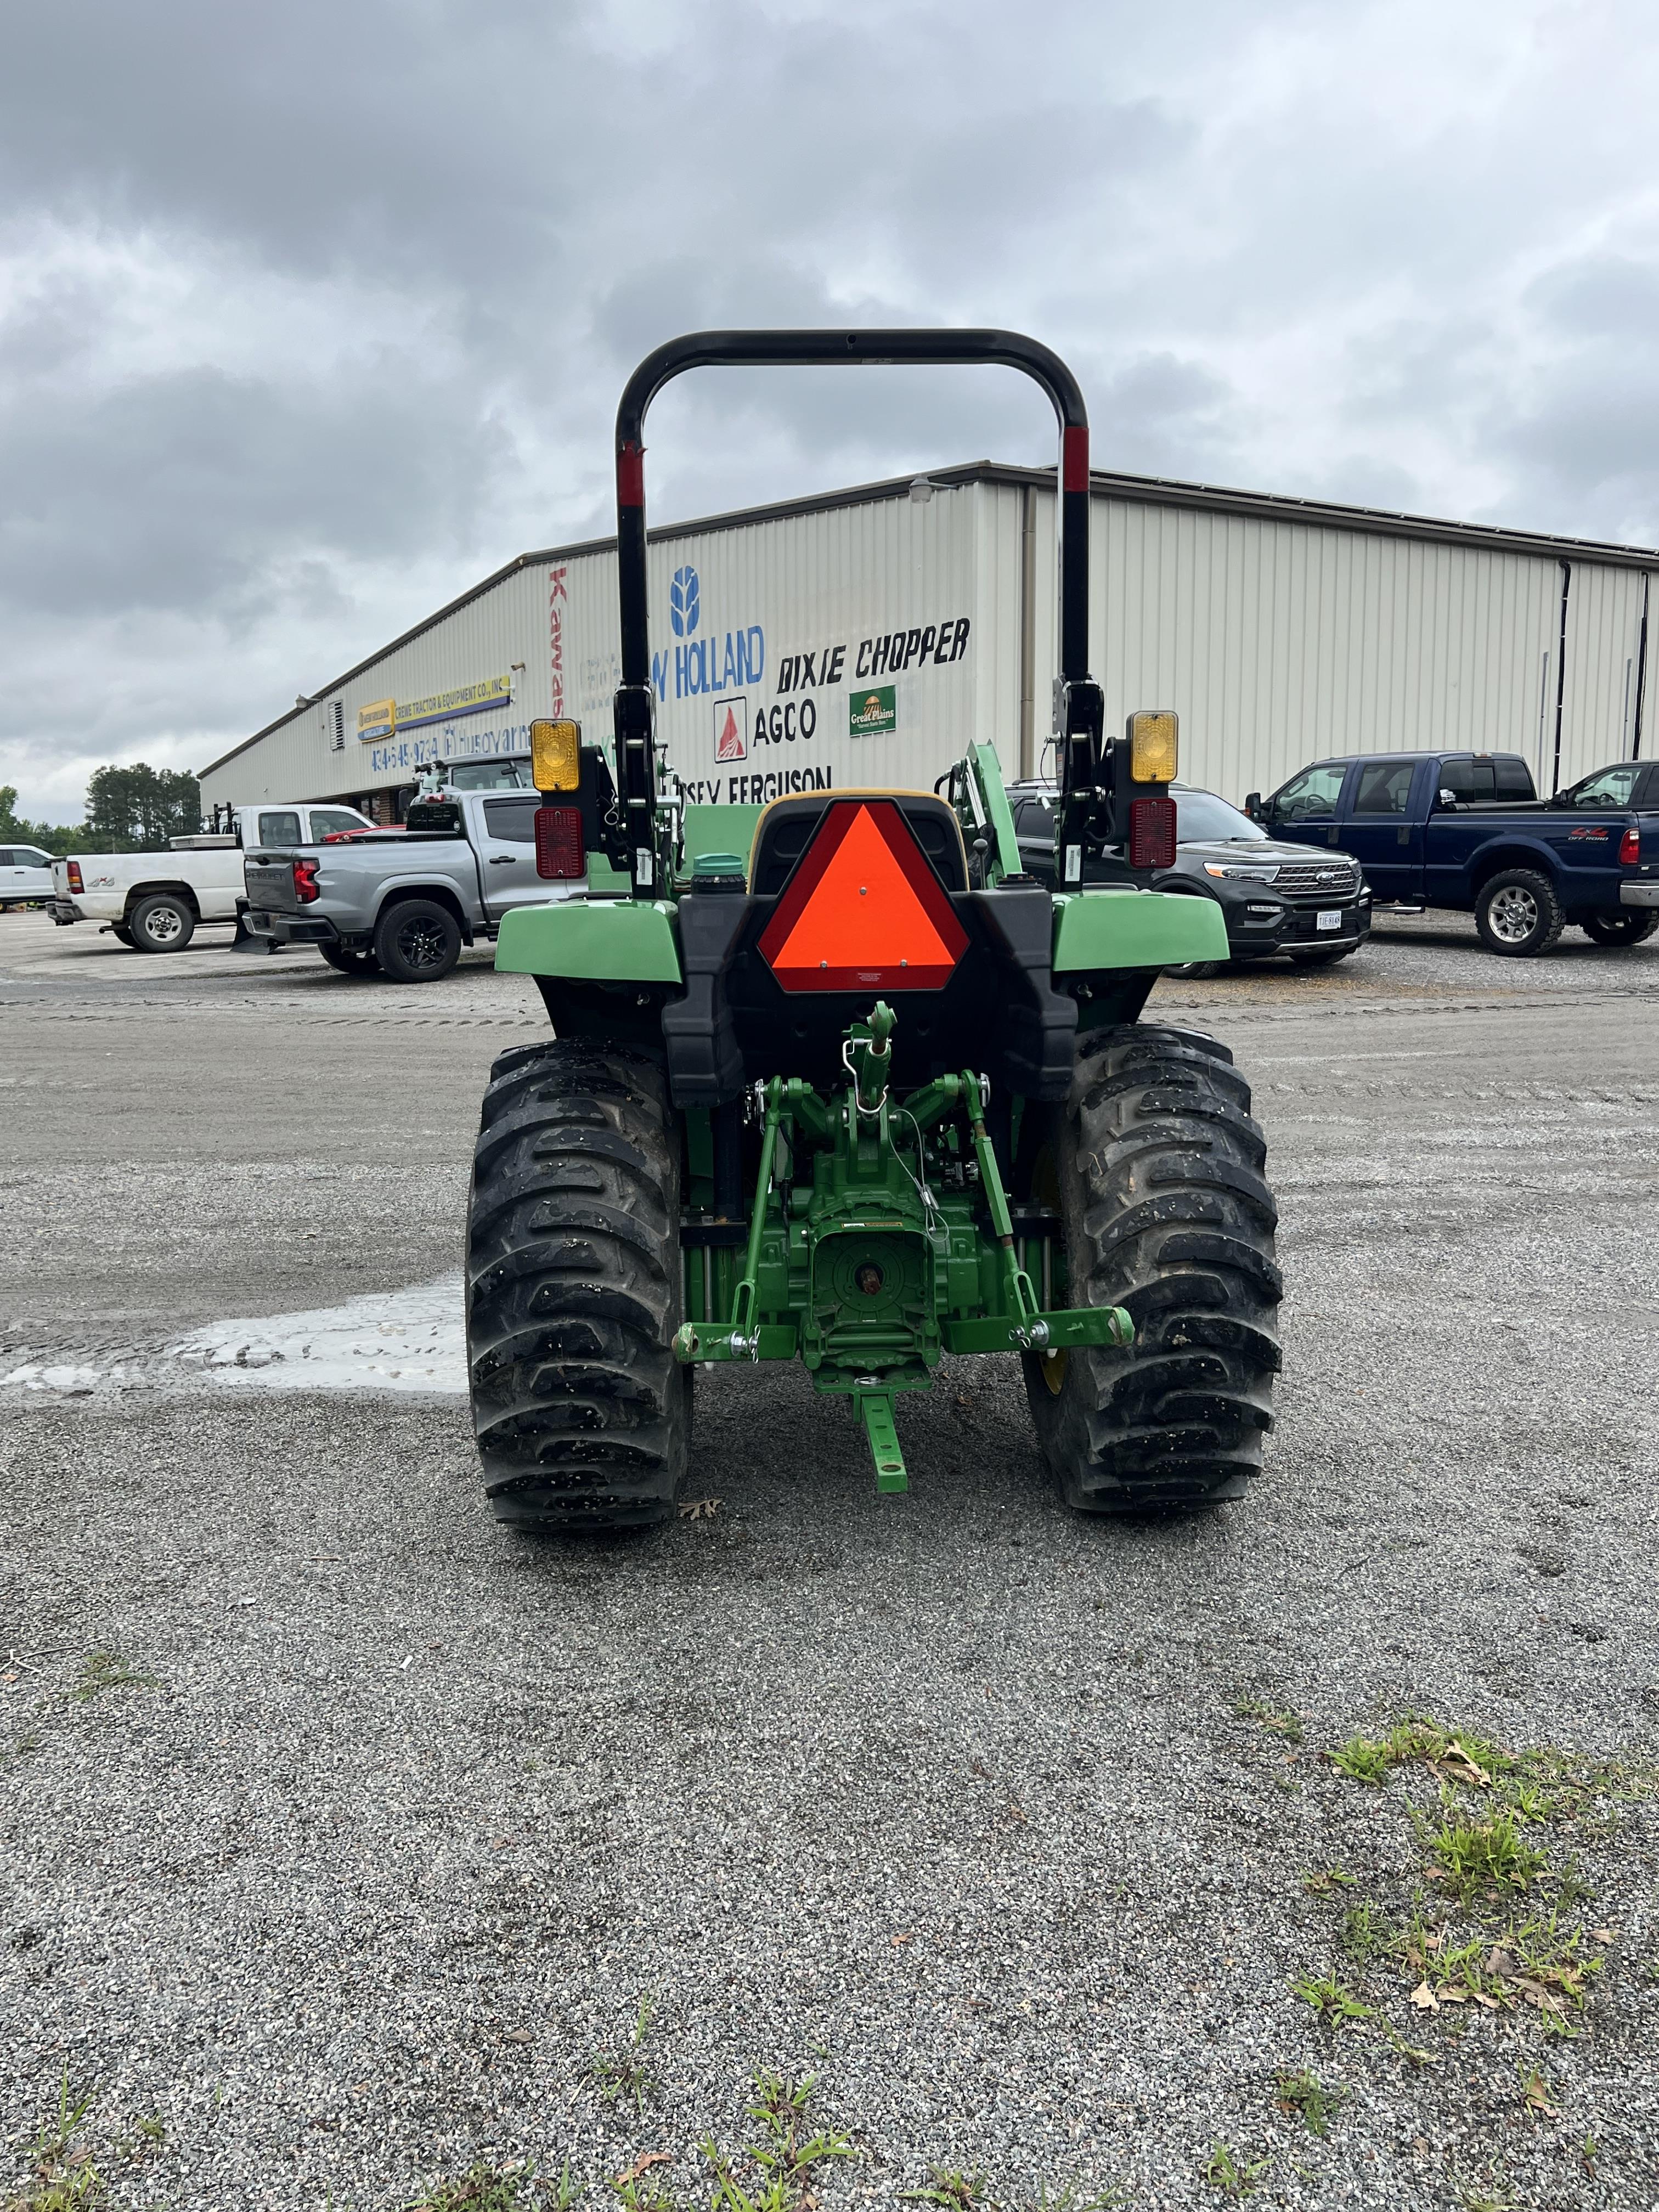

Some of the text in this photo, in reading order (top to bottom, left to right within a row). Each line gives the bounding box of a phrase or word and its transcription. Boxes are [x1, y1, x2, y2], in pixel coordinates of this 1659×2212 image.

[550, 567, 567, 718] Kawas
[675, 625, 764, 698] HOLLAND
[776, 618, 970, 695] DIXIE CHOPPER
[395, 704, 411, 720] CREWE
[413, 697, 436, 714] TRACTOR
[437, 696, 442, 708] &
[442, 686, 476, 709] EQUIPMENT
[753, 698, 816, 747] AGCO
[851, 713, 872, 724] Great
[872, 708, 894, 720] Plains
[729, 766, 832, 805] FERGUSON
